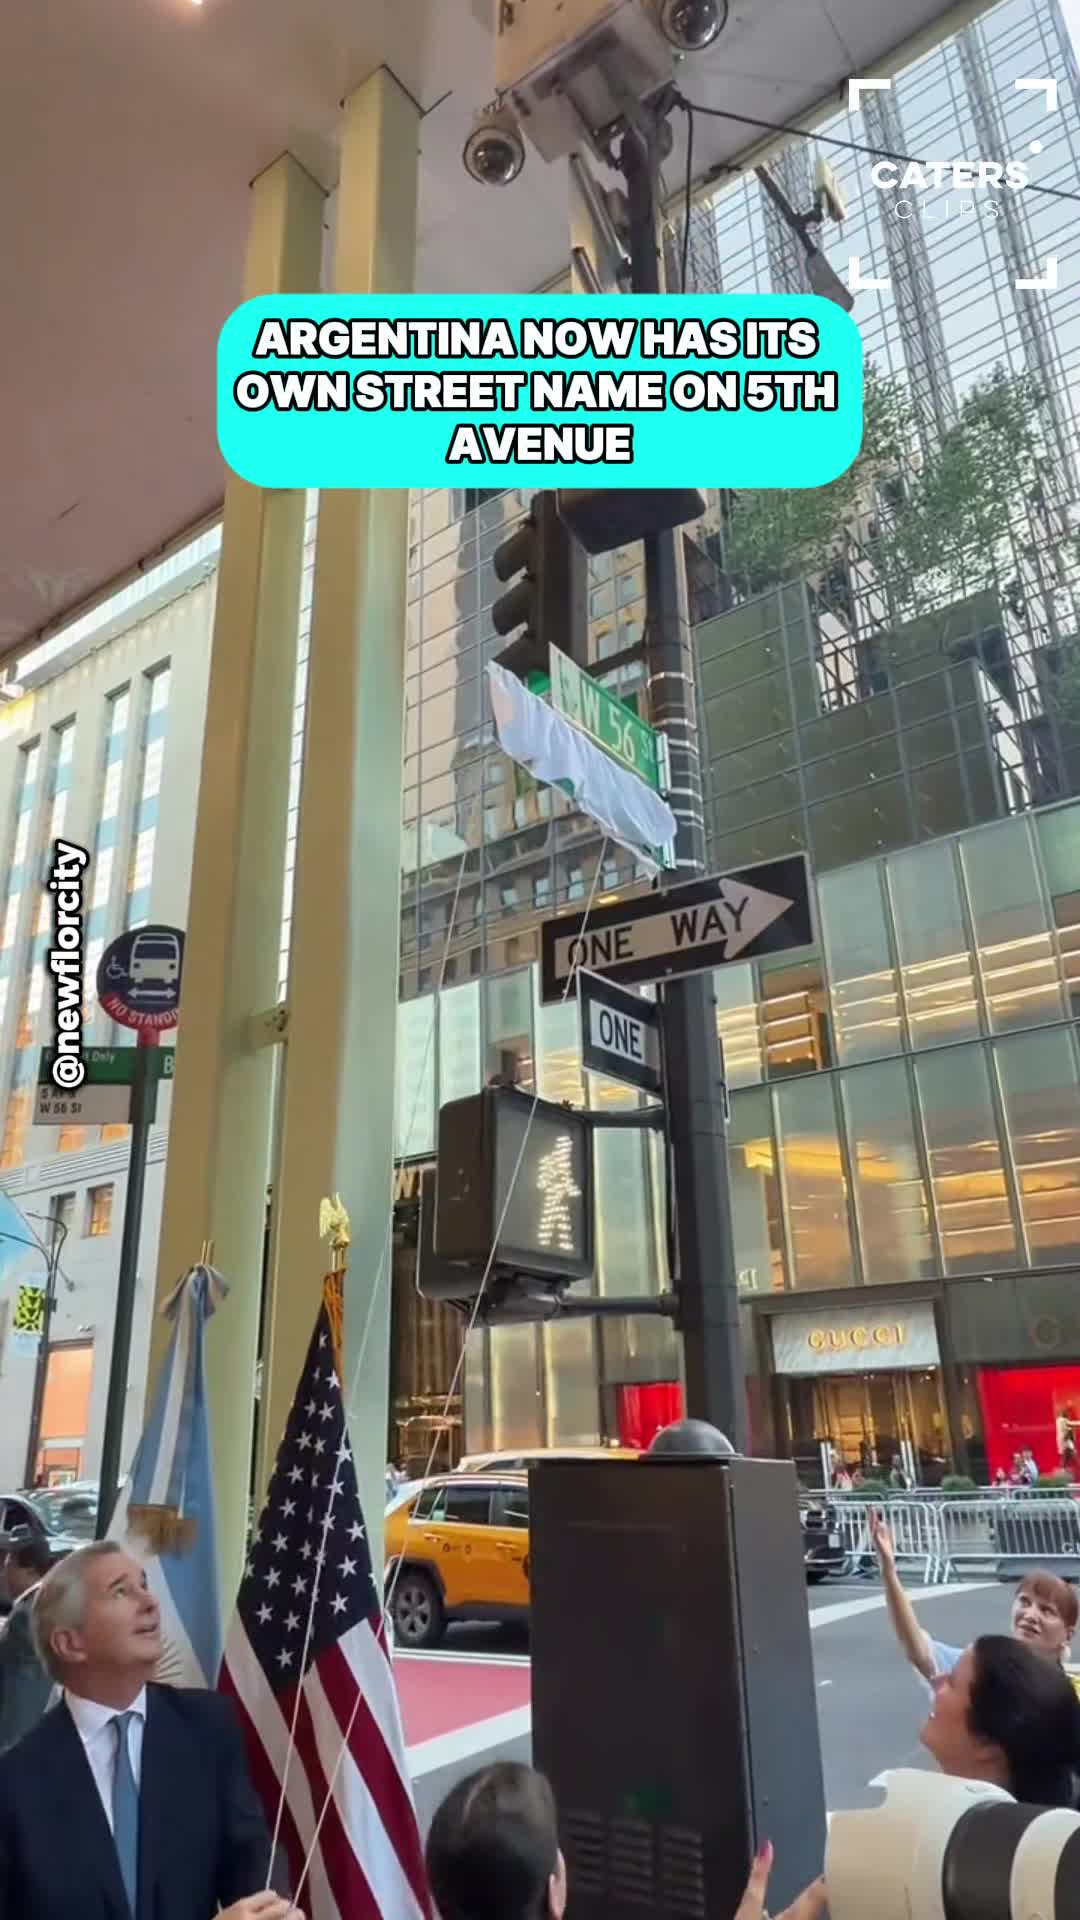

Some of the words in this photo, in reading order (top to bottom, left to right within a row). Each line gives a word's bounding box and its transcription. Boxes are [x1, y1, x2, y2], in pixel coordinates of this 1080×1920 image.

[580, 679, 600, 738] W
[607, 702, 636, 763] 56
[568, 925, 634, 967] ONE
[670, 896, 751, 947] WAY
[105, 997, 129, 1018] NO
[599, 1010, 643, 1060] ONE
[40, 1104, 50, 1113] W
[808, 1324, 905, 1352] GUCCI
